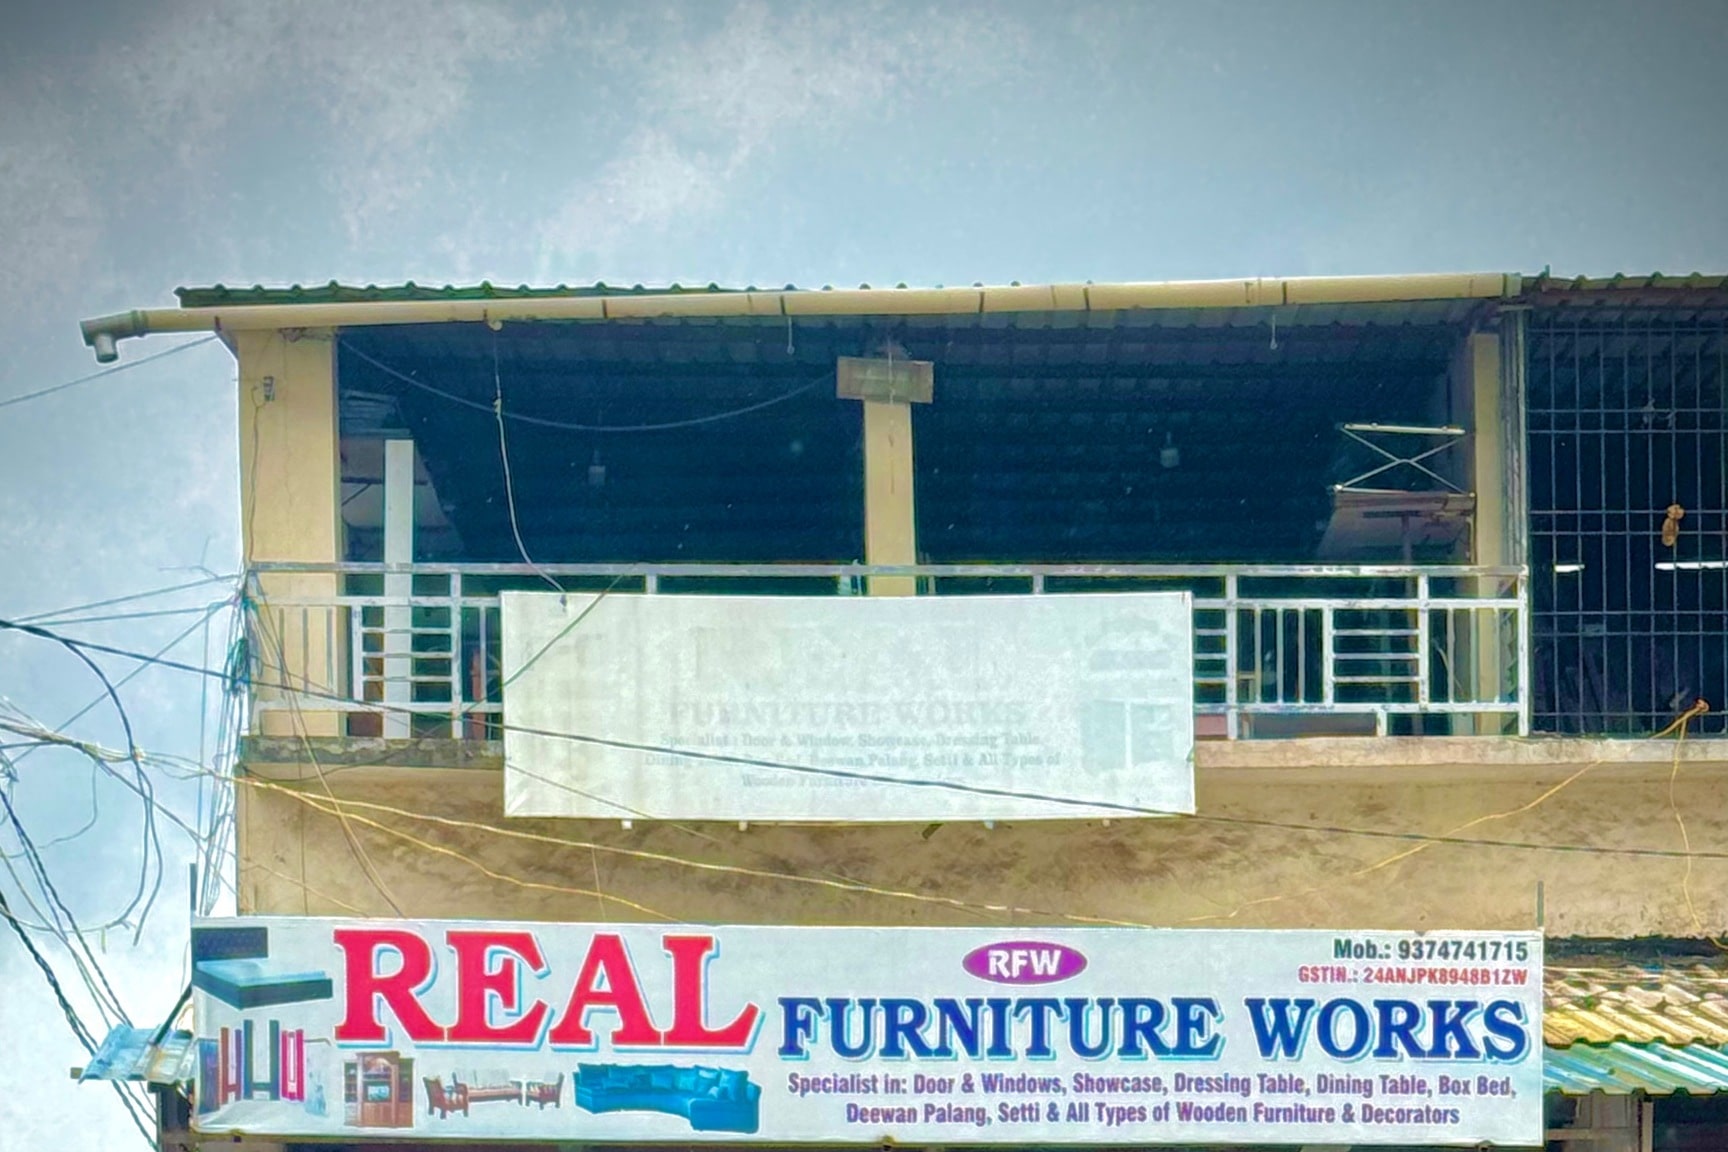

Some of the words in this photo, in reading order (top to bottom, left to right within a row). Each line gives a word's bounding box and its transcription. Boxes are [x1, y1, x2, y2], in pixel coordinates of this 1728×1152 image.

[1334, 938, 1390, 960] Mob.:
[1397, 939, 1529, 961] 9374741715
[988, 950, 1063, 976] RFW
[333, 927, 763, 1051] REAL
[777, 995, 1224, 1061] FURNITURE
[1246, 995, 1529, 1061] WORKS
[787, 1073, 878, 1098] Specialist
[884, 1073, 907, 1095] in:
[914, 1073, 954, 1095] Door
[961, 1074, 974, 1094] &
[982, 1073, 1066, 1097] Windows,
[1073, 1073, 1168, 1097] Showcase,
[1174, 1073, 1250, 1098] Dressing
[1257, 1074, 1310, 1097] Table,
[1317, 1074, 1373, 1099] Dining
[1379, 1075, 1432, 1098] Table,
[1439, 1075, 1470, 1096] Box
[1477, 1075, 1517, 1098] Bed,
[846, 1103, 916, 1123] Deewan
[924, 1103, 991, 1127] Palang,
[998, 1103, 1039, 1123] Setti
[1046, 1103, 1060, 1123] &
[1066, 1103, 1089, 1123] All
[1095, 1103, 1147, 1126] Types
[1152, 1103, 1170, 1123] of
[1176, 1103, 1247, 1123] Wooden
[1253, 1103, 1335, 1123] Furniture
[1342, 1103, 1355, 1123] &
[1361, 1103, 1460, 1125] Decorators
